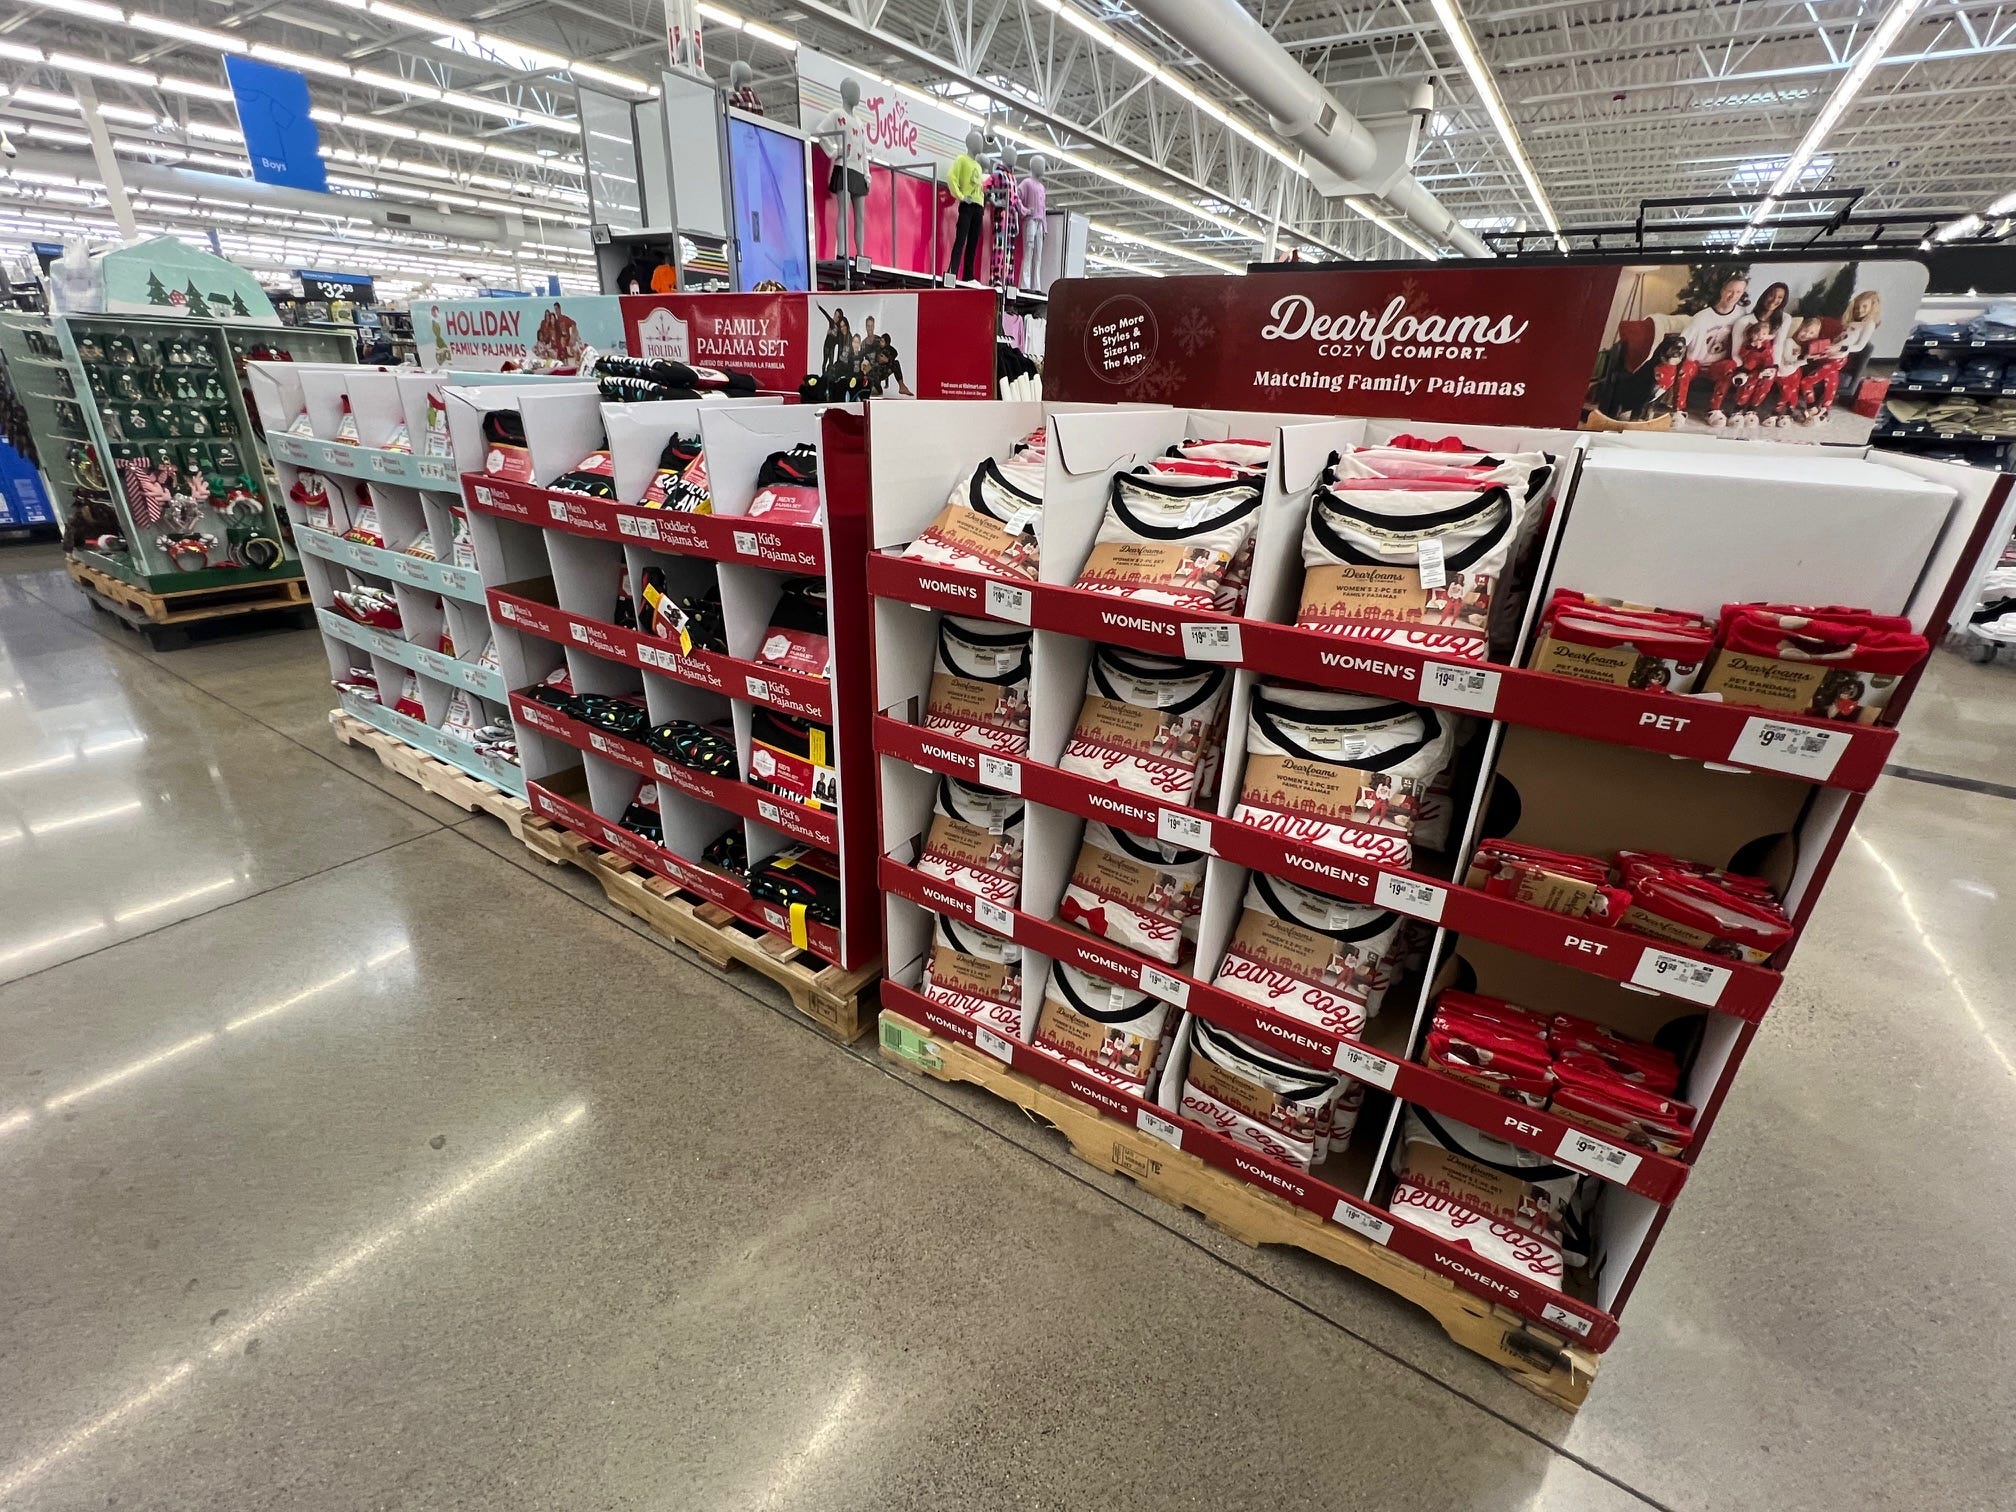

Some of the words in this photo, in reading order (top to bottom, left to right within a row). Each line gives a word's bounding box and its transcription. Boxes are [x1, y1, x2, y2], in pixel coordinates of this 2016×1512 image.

[866, 96, 918, 156] Justice
[262, 157, 287, 171] Boys
[445, 310, 521, 337] HOLIDAY
[714, 318, 770, 336] FAMILY
[1092, 323, 1117, 337] Shop
[1119, 315, 1145, 329] More
[1261, 294, 1529, 361] Dearfoams
[1102, 331, 1130, 346] Styles
[1132, 326, 1141, 337] &
[449, 342, 479, 356] FAMILY
[481, 342, 527, 358] PAJAMAS
[647, 344, 682, 358] HOLIDAY
[696, 337, 756, 356] PAJAMA
[758, 339, 789, 357] SET
[1103, 345, 1127, 358] Sizes
[1130, 341, 1140, 350] In
[1318, 344, 1365, 357] COZY
[1391, 345, 1486, 360] COMFORT
[1103, 359, 1120, 370] The
[1122, 353, 1146, 366] App.
[1253, 370, 1344, 393] Matching
[1348, 374, 1422, 395] Family
[1426, 376, 1526, 398] Pajamas
[565, 501, 587, 515] Men's
[568, 514, 594, 529] Pajama
[595, 519, 608, 532] Set
[657, 518, 697, 534] Toddler's
[661, 531, 693, 547] Pajama
[693, 537, 709, 550] Set
[757, 532, 782, 547] Kid's
[1120, 543, 1165, 555] Dearfoams
[760, 546, 797, 563] Pajama
[798, 552, 817, 566] Set
[1341, 568, 1405, 581] Dearfoams
[919, 577, 978, 599] WOMEN'S
[586, 625, 608, 640] Men's
[1101, 611, 1176, 636] WOMEN'S
[588, 638, 614, 654] Pajama
[614, 644, 627, 657] Set
[1553, 646, 1628, 667] Dearfoams
[675, 653, 712, 673] Toddler's
[1320, 651, 1416, 681] WOMEN'S
[1574, 666, 1614, 679] BANDANA
[1727, 658, 1815, 680] Dearfoams
[677, 665, 707, 683] Pajama
[707, 674, 722, 687] Set
[1749, 679, 1797, 693] BANDANA
[768, 681, 791, 696] Kid's
[1723, 682, 1753, 691] FAMILY
[1754, 687, 1796, 699] PAJAMAS
[770, 693, 804, 712] Pajama
[805, 703, 822, 718] Set
[1639, 712, 1691, 732] PET
[921, 743, 976, 768] WOMEN'S
[1282, 759, 1338, 776] Dearfoams
[779, 806, 801, 822] Kid's
[1088, 794, 1156, 823] WOMEN'S
[781, 818, 814, 838] Pajama
[815, 829, 831, 845] Set
[1284, 852, 1370, 887] WOMEN'S
[923, 886, 973, 913] WOMEN'S
[1564, 935, 1608, 956] PET
[1077, 948, 1139, 979] WOMEN'S
[1219, 955, 1297, 999] beary
[1302, 989, 1366, 1035] cozy
[926, 1011, 974, 1039] WOMEN'S
[1255, 1018, 1332, 1055] WOMEN'S
[1070, 1081, 1128, 1113] WOMEN'S
[1504, 1116, 1543, 1136] PET
[1235, 1157, 1305, 1197] WOMEN'S
[1489, 1221, 1562, 1276] cozy
[1434, 1252, 1520, 1299] WOMEN'S
